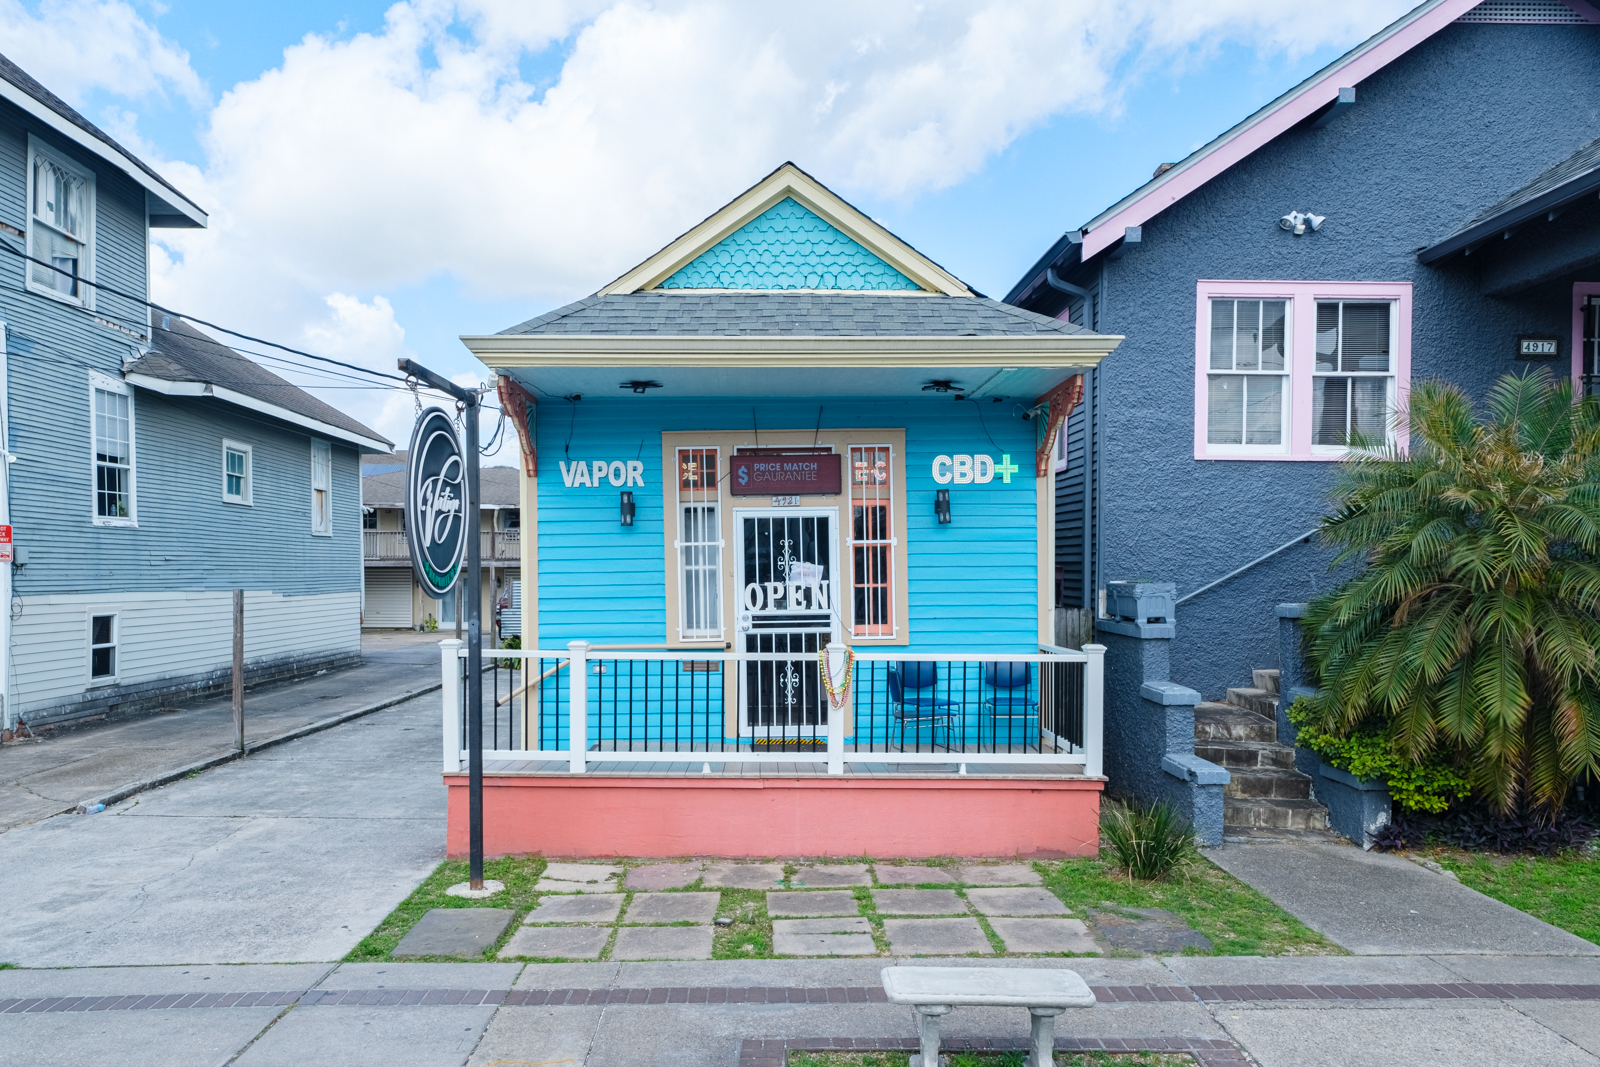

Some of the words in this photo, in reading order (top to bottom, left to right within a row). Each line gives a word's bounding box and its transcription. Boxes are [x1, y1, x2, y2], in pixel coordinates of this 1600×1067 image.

[1524, 342, 1553, 352] 4917
[754, 463, 780, 471] PRICE
[783, 462, 817, 471] MATCH
[559, 460, 645, 487] VAPOR
[753, 471, 817, 481] GAURANTEE
[773, 496, 798, 505] 4921
[744, 580, 829, 611] OPEN
